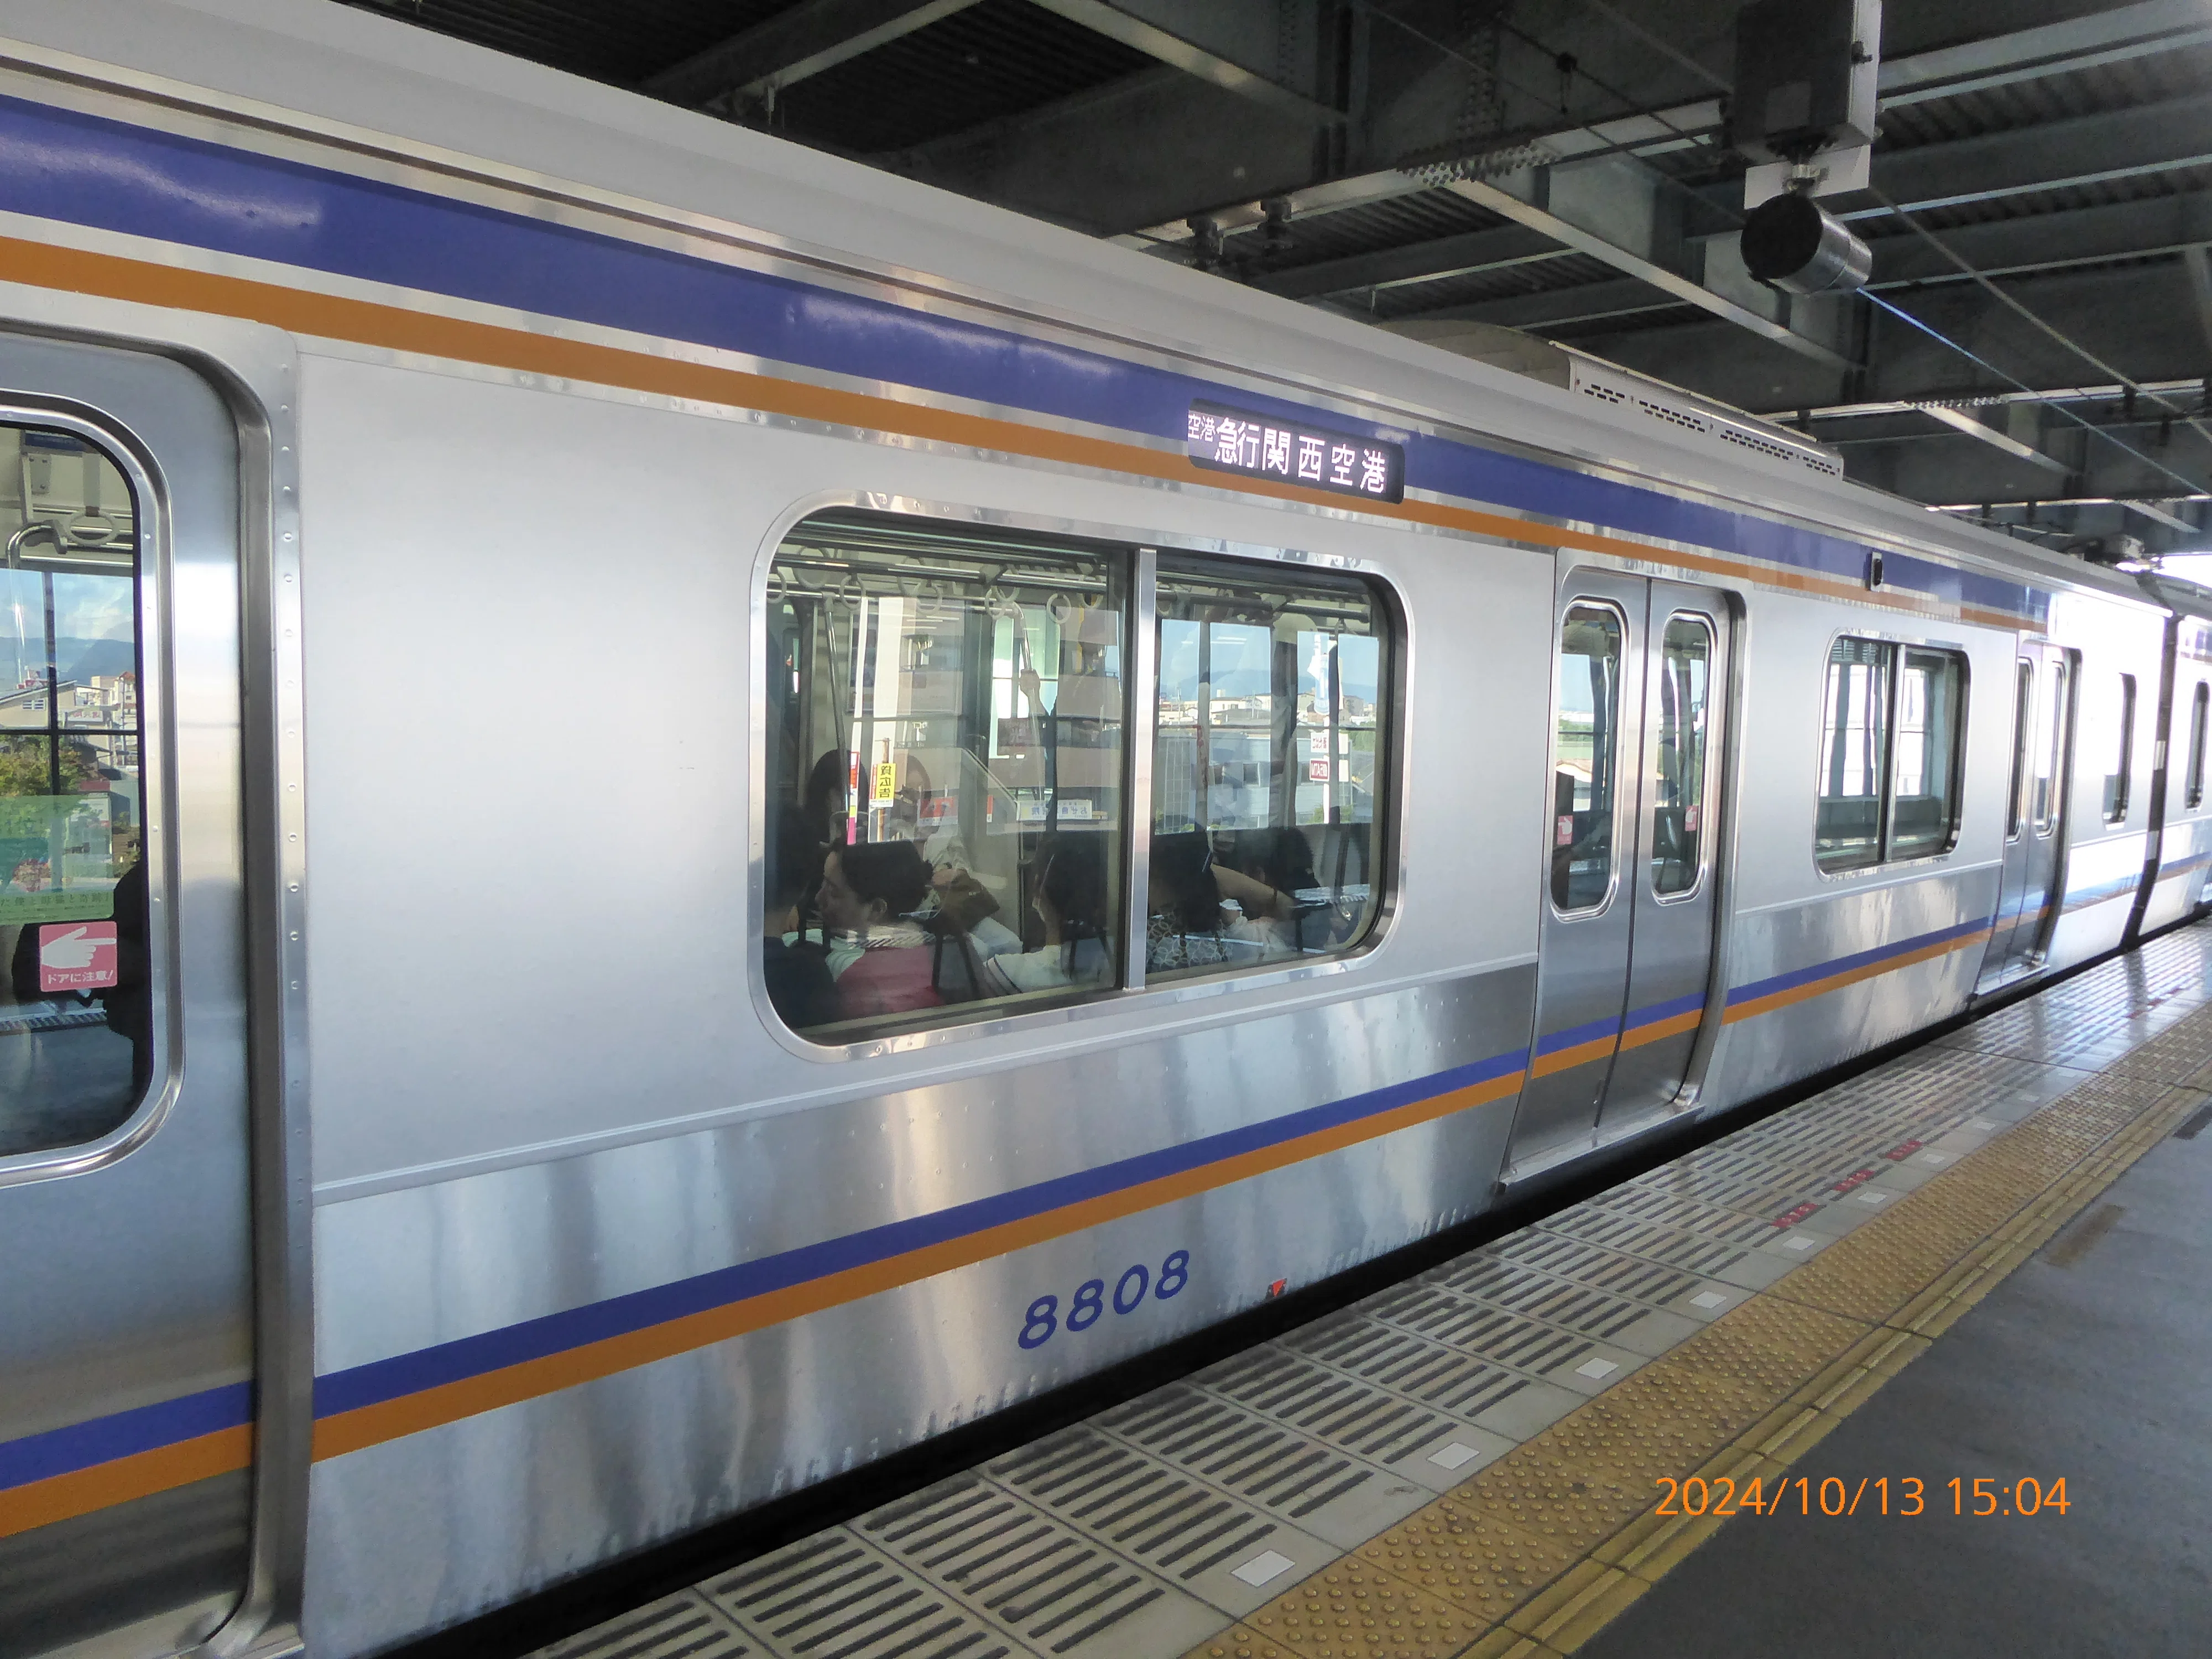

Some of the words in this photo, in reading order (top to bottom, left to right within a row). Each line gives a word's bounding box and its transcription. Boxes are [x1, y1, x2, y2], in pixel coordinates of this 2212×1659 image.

[1261, 427, 1386, 494] 関西空港
[47, 969, 114, 984] ドアに注意!
[1018, 1250, 1190, 1349] 8808
